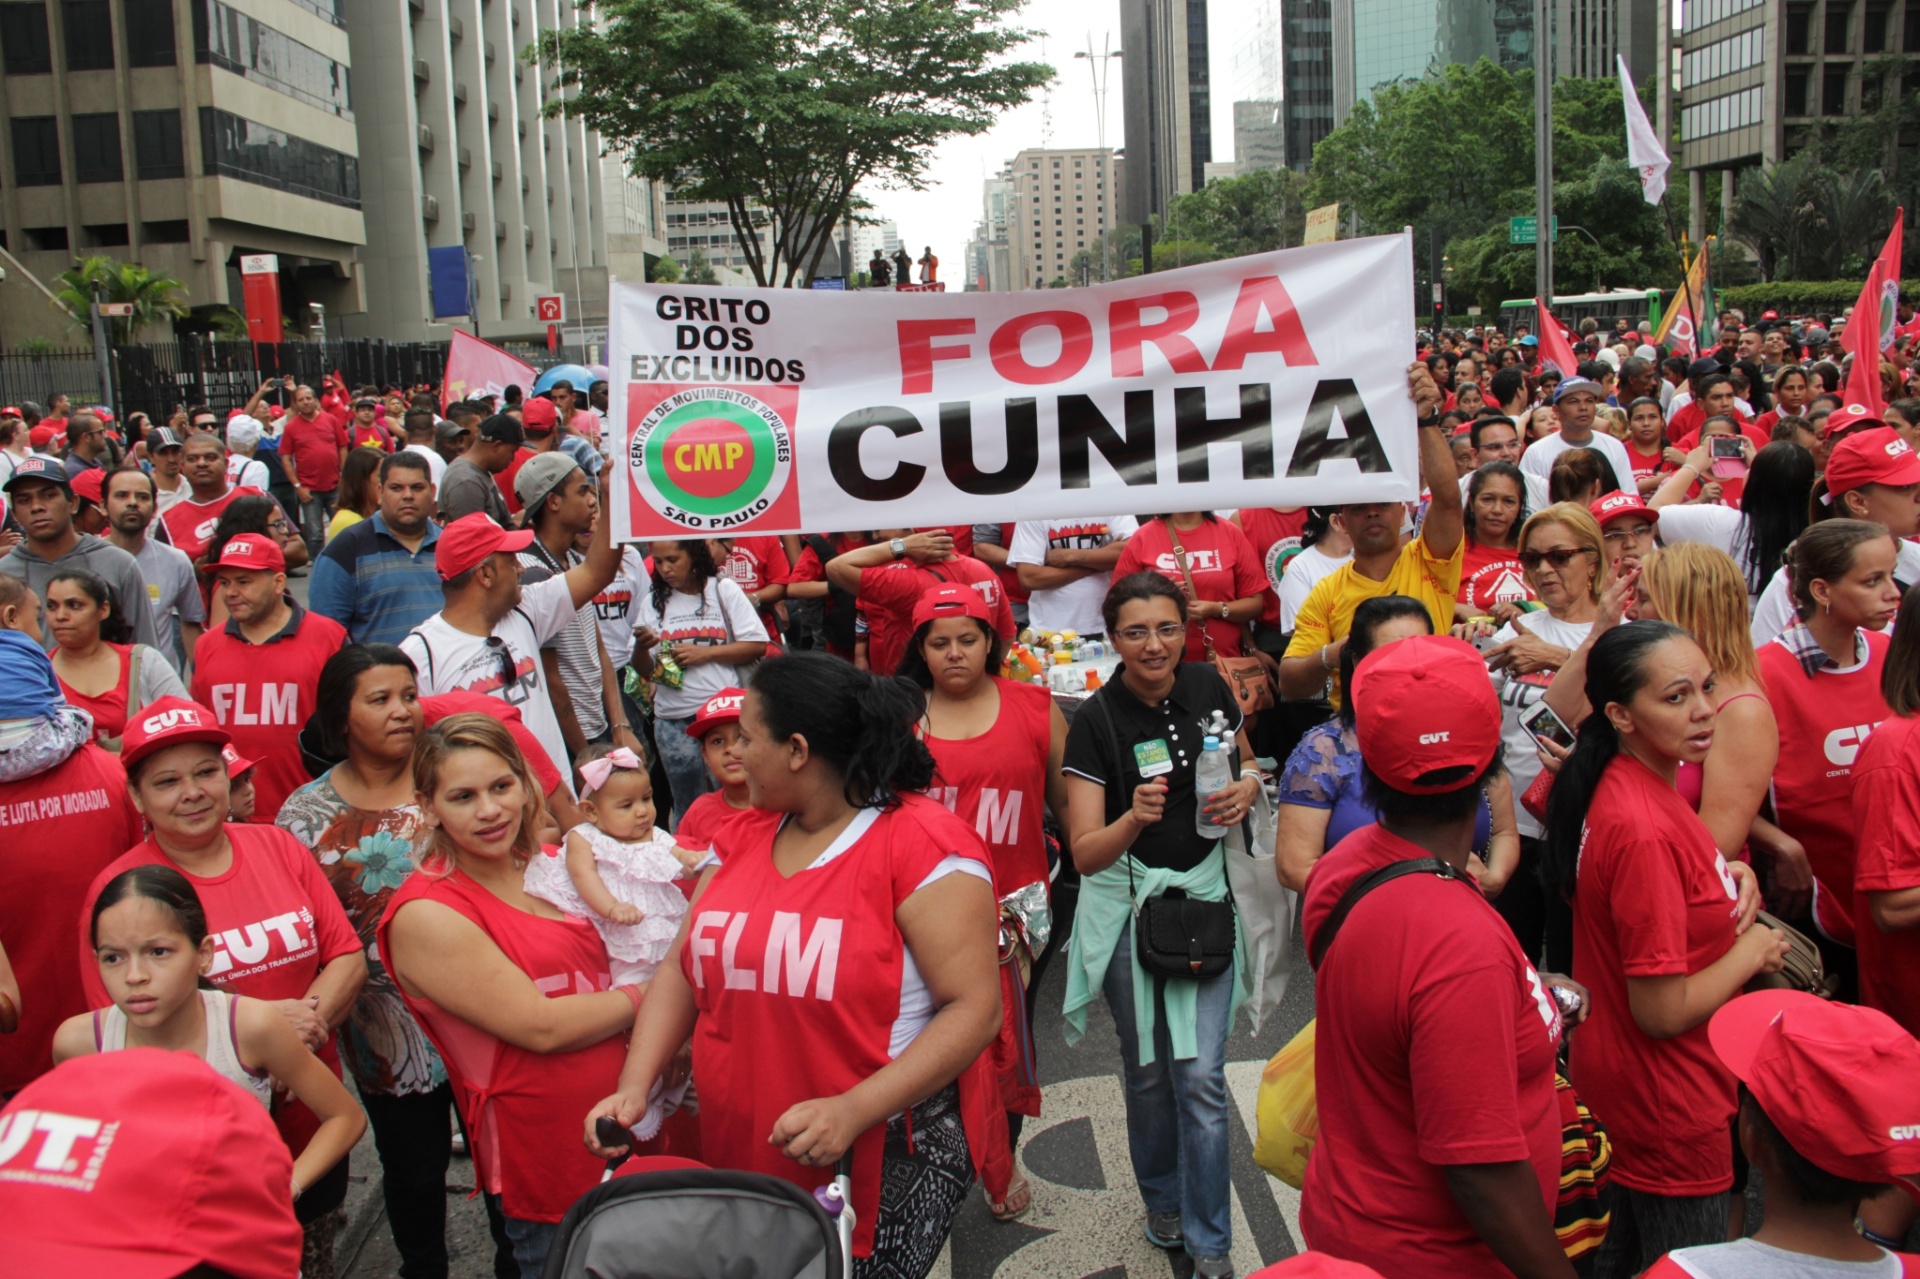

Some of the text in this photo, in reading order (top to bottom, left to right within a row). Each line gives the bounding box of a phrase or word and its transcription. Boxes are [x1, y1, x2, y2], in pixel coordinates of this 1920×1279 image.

[656, 295, 770, 325] GRITO
[676, 325, 754, 351] DOS
[897, 275, 1319, 395] FORA
[630, 354, 806, 383] EXCLUIDOS
[631, 388, 790, 467] CENTRAL DE MOVIMENTOS POPULARES
[827, 378, 1393, 502] CUNHA
[674, 442, 744, 473] CMP
[1885, 438, 1909, 456] CU
[663, 498, 769, 528] SÃO PAULO
[1601, 496, 1635, 511] CUT
[225, 541, 250, 555] CUT
[1479, 562, 1503, 575] LUTAS
[211, 683, 299, 725] FLM
[707, 696, 744, 713] CUT
[143, 709, 195, 734] CUT
[1419, 731, 1450, 745] CUT
[1137, 747, 1167, 759] ESTAMOS
[1147, 754, 1168, 763] VENDA
[1826, 769, 1851, 778] CENTR
[9, 801, 39, 825] LUTA
[39, 796, 63, 819] POR
[62, 788, 111, 815] MORADIA
[299, 906, 318, 948] BRASIL
[205, 912, 301, 977] CUT
[690, 910, 844, 1001] FLM
[228, 970, 251, 980] ÚNICA
[252, 964, 268, 973] DOS
[0, 1110, 101, 1171] UT
